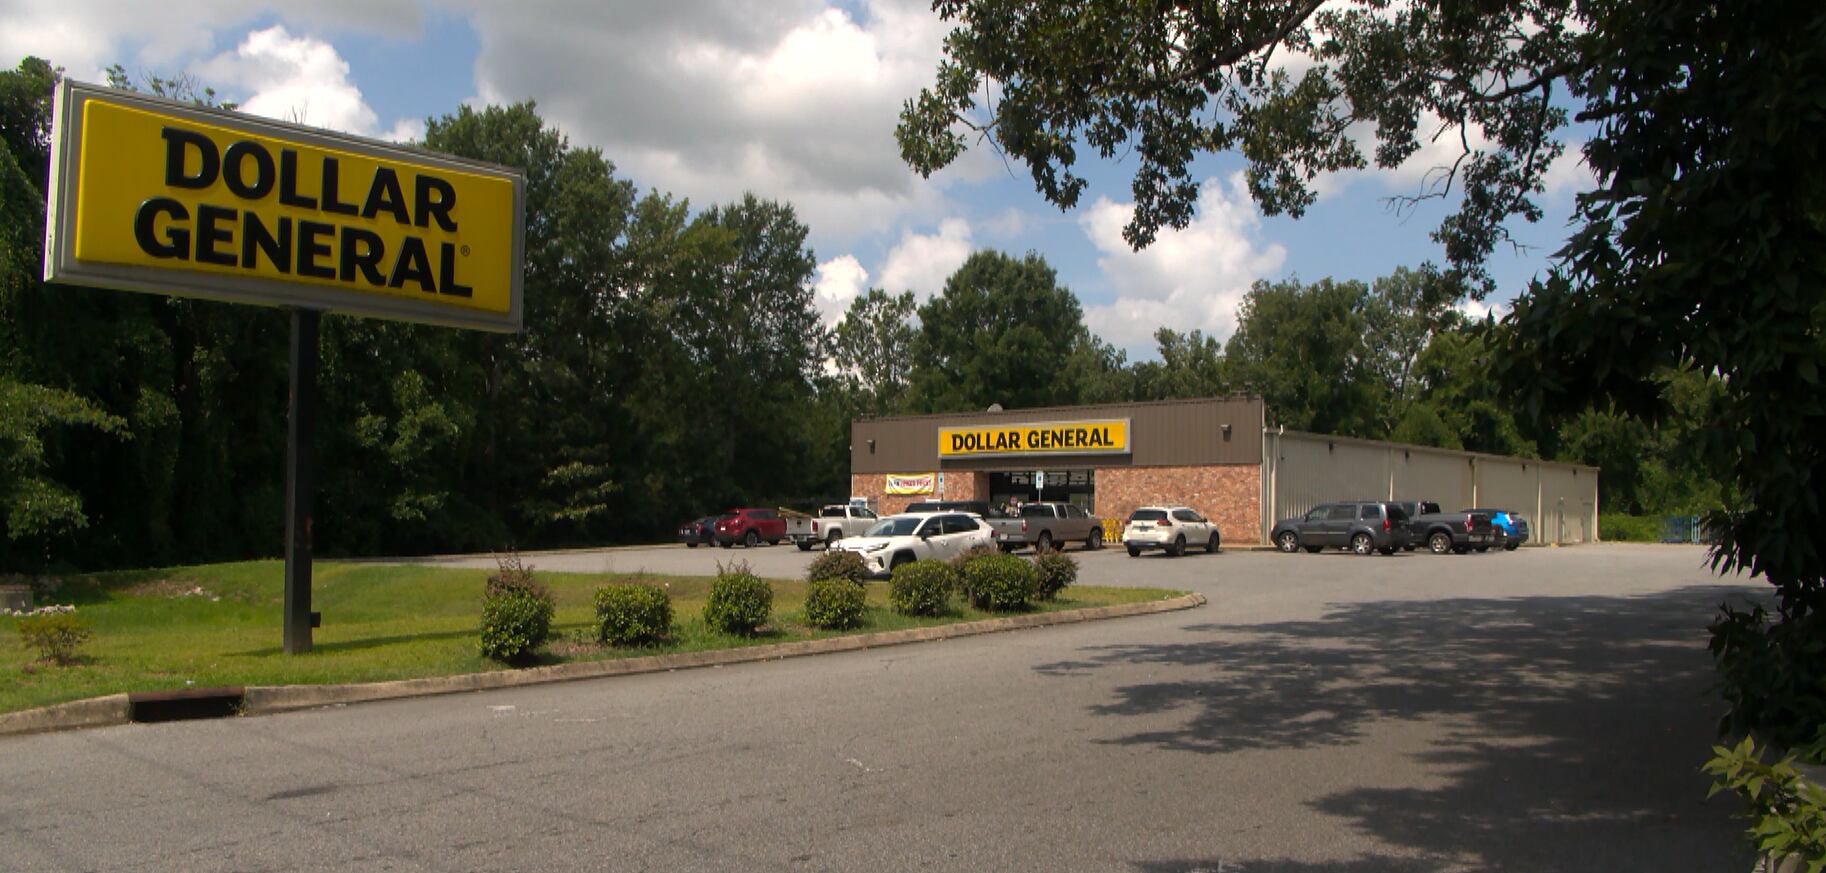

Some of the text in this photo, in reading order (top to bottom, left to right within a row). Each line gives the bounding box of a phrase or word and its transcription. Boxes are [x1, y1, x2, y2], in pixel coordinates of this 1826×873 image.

[161, 126, 458, 232] DOLLAR
[952, 428, 1114, 451] DOLLAR GENERAL
